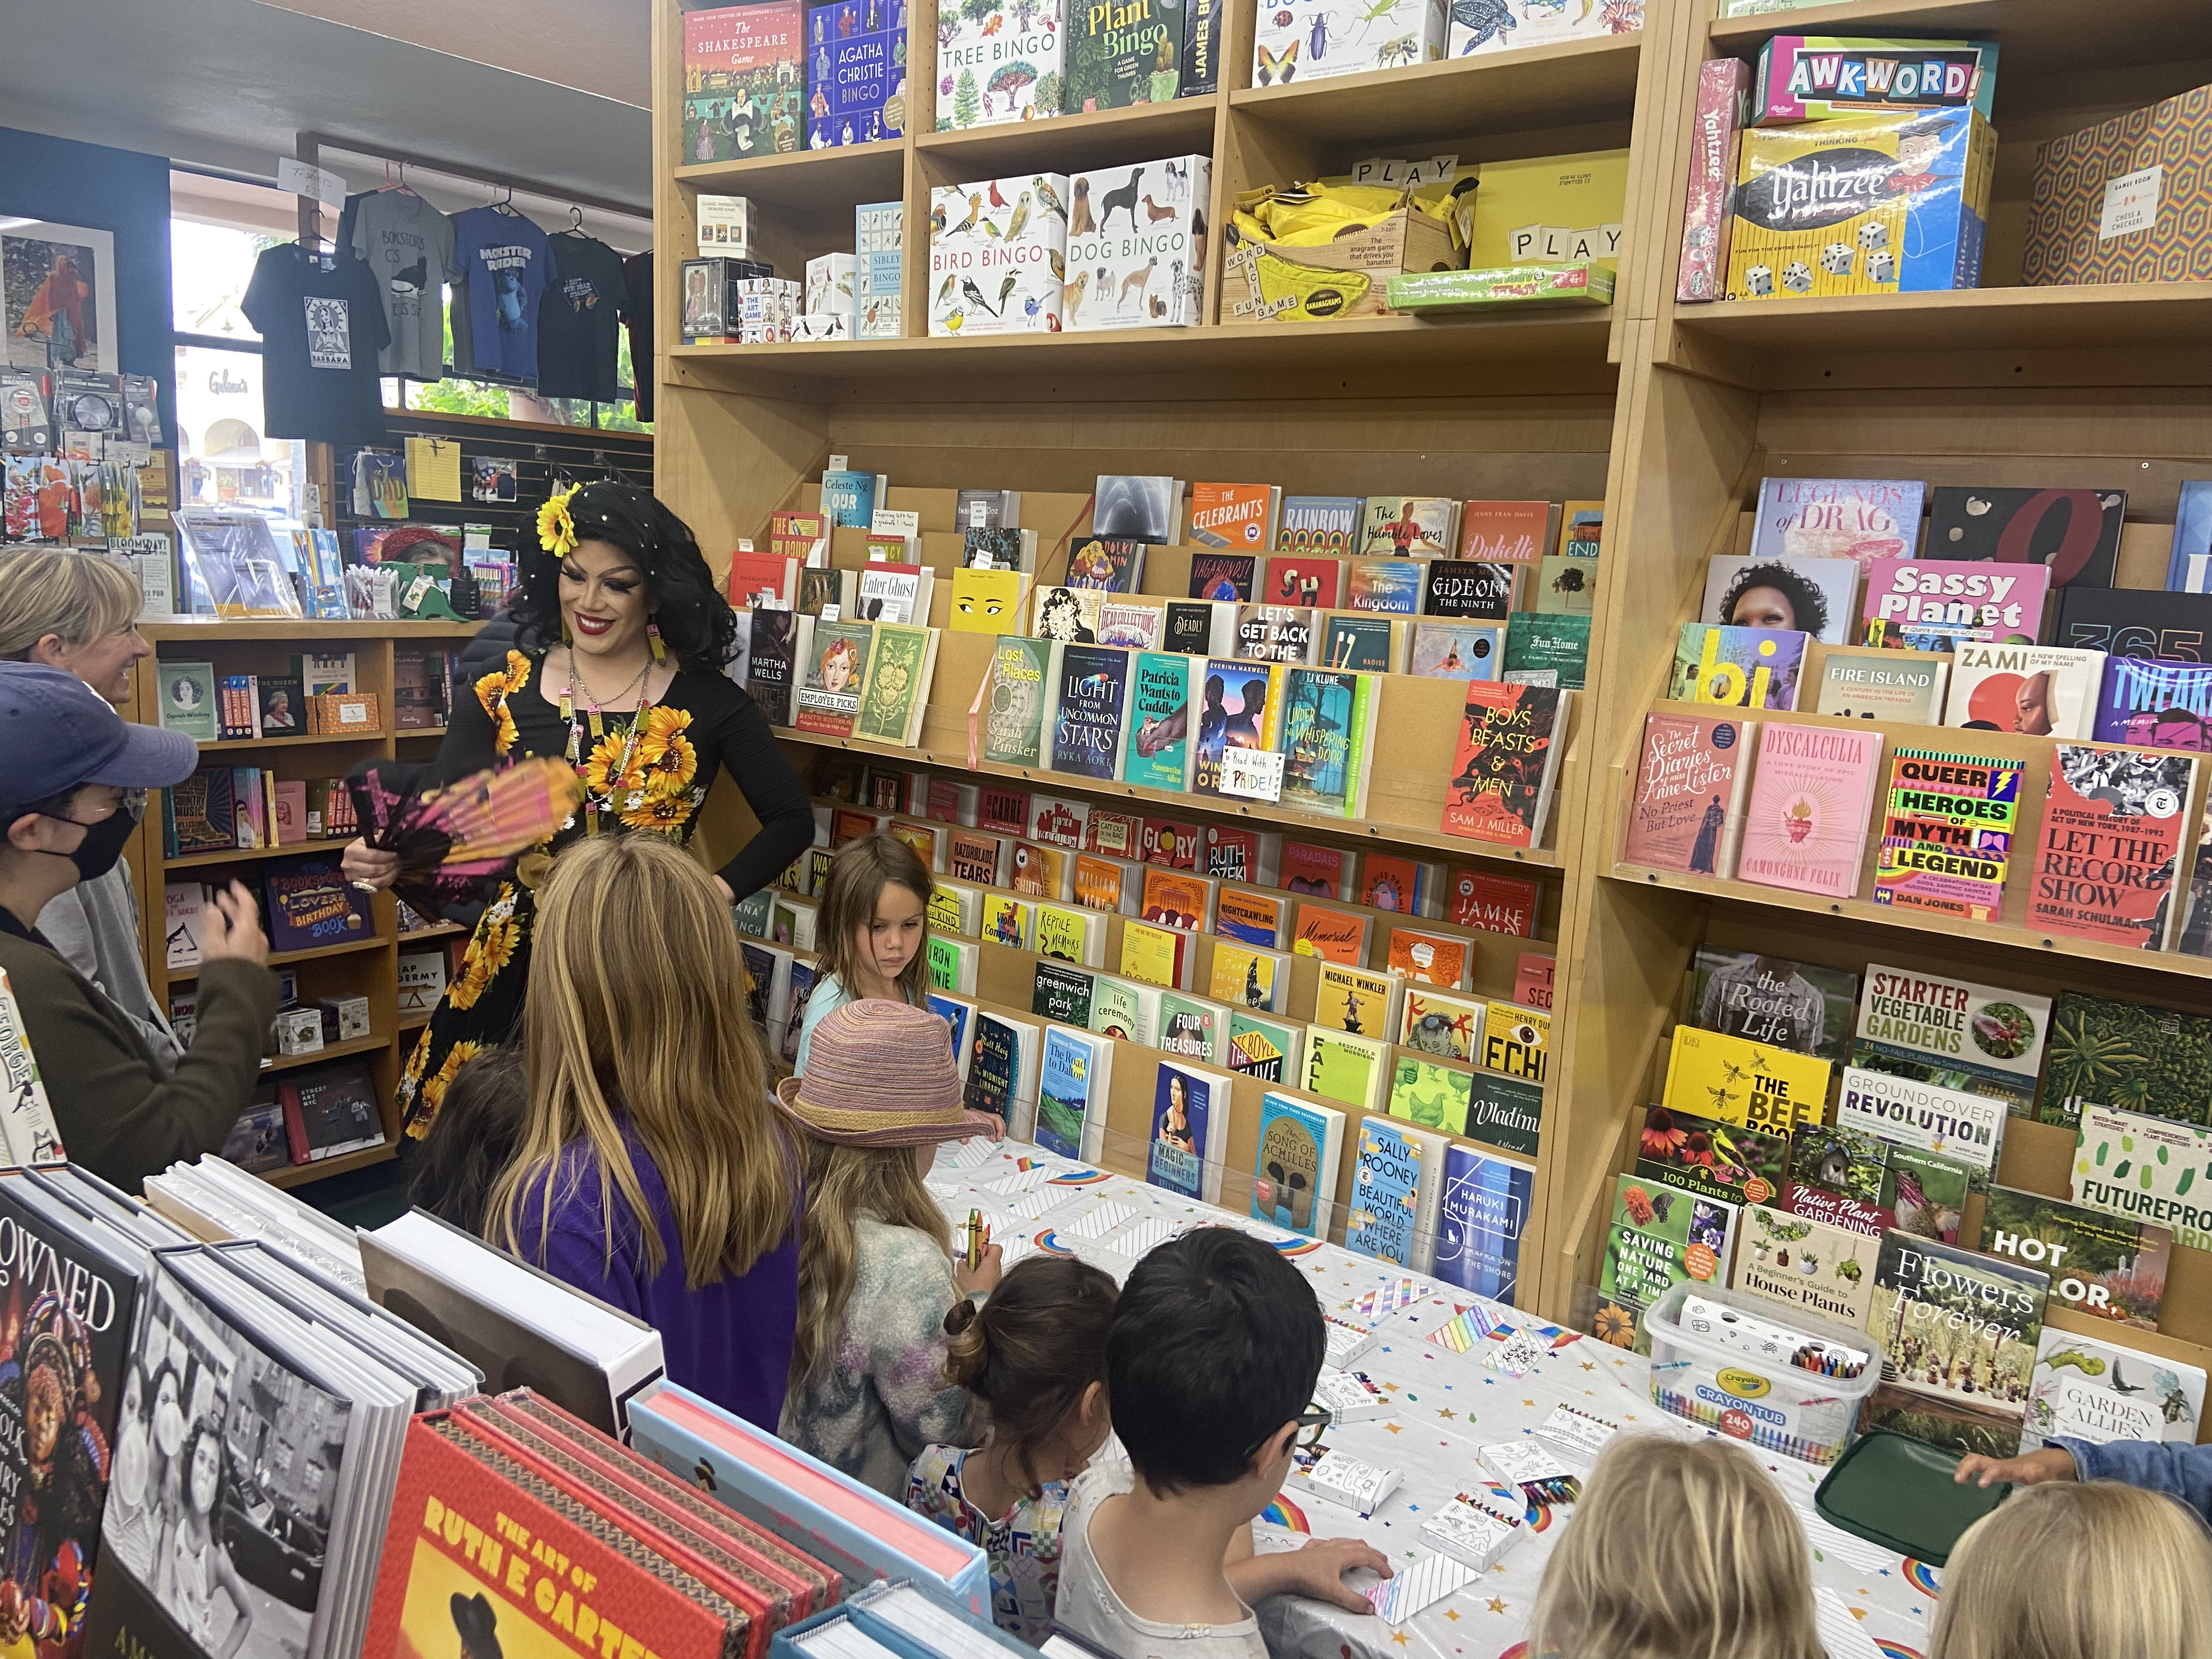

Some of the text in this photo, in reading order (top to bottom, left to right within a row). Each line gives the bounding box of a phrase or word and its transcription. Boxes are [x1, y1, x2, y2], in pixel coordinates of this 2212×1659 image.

[736, 21, 751, 34] The
[698, 33, 788, 53] SHAKESPEARE
[943, 33, 1056, 68] TREE BINGO
[1103, 24, 1167, 59] Bingo
[731, 53, 754, 65] Game
[838, 43, 883, 64] AGATHA
[838, 61, 884, 84] CHRISTIE
[1787, 55, 1982, 100] AWK-WORD!
[842, 84, 879, 104] BINGO
[1814, 136, 1858, 147] THINKING
[1770, 160, 1886, 220] Yahtzee
[2112, 217, 2143, 231] CHECKERS
[2115, 212, 2135, 222] CHESS
[934, 246, 1042, 271] BIRD BINGO
[1070, 232, 1184, 263] DOG BINGO
[1773, 244, 1795, 252] ENTIRE
[1306, 296, 1342, 311] BANANAGRAMS
[744, 312, 761, 320] GAME
[825, 479, 867, 492] Celeste Ng
[1221, 490, 1234, 502] THE
[1193, 499, 1263, 530] CELEBRANTS
[110, 539, 166, 550] BLOOMSDAY!
[863, 574, 915, 598] Enter Ghost
[1891, 566, 2017, 603] Sassy
[1257, 606, 1294, 622] LET'S
[1877, 594, 2022, 628] Planet
[1240, 624, 1309, 643] GET BACK
[752, 657, 787, 669] MARTHA
[998, 645, 1023, 662] Lost
[1962, 648, 2027, 671] ZAMI
[2055, 654, 2086, 663] SPELLING
[754, 668, 782, 680] WELLS
[1002, 663, 1040, 682] Places
[1210, 663, 1268, 675] EVERINA MAXWELL
[1307, 673, 1339, 686] TJ KLUNE
[1695, 629, 1776, 709] bi
[1831, 668, 1929, 687] FIRE ISLAND
[1068, 675, 1118, 703] LIGHT
[801, 693, 856, 709] EMPLOYEE PICKS
[1079, 699, 1101, 709] FROM
[1062, 707, 1118, 726] UNCOMMON
[1485, 707, 1532, 727] BOYS
[991, 721, 1022, 738] Sarah
[1059, 721, 1113, 752] STARS
[1471, 729, 1535, 753] BEASTS
[992, 737, 1036, 757] Pinsker
[1766, 730, 1862, 764] DYSCALCULIA
[1233, 770, 1272, 792] PRIDE!
[1474, 776, 1513, 798] MEN
[1901, 763, 1988, 788] QUEER
[1901, 792, 2007, 820] HEROES
[1450, 812, 1524, 836] SAM MILLER
[1951, 817, 1966, 826] OF
[2051, 815, 2066, 823] ACT
[2080, 819, 2098, 828] NEW
[2100, 821, 2119, 833] YORK,
[2121, 825, 2164, 837] 1987-1993
[1893, 820, 1971, 847] MYTH
[955, 842, 994, 865] RAZORBLADE
[1916, 842, 1943, 853] AND
[954, 860, 990, 884] TEARS
[1746, 857, 1840, 887] CAMONGHNE FELIX
[1897, 851, 1998, 879] LEGEND
[1897, 893, 1964, 912] DAN JONES
[2039, 877, 2125, 909] SHOW
[296, 903, 343, 927] BIRTHDAY
[1221, 904, 1273, 925] NIGHTCRAWLING
[2036, 903, 2076, 920] SARAH
[312, 918, 347, 937] BOOK
[1037, 975, 1090, 998] greenwich
[1324, 970, 1386, 996] MICHAEL WINKLER
[1757, 971, 1786, 994] the
[1874, 973, 1968, 1012] STARTER
[1048, 996, 1072, 1012] park
[1728, 983, 1810, 1022] Rooted
[1871, 995, 1966, 1031] VEGETABLE
[1176, 1014, 1201, 1031] FOUR
[1741, 1011, 1788, 1042] Life
[1866, 1014, 1962, 1054] GARDENS
[1160, 1035, 1212, 1057] TREASURES
[1338, 1041, 1369, 1053] GEOFFREY
[1343, 1047, 1375, 1060] MORRISON
[301, 1085, 326, 1096] STREET
[1848, 1075, 1995, 1123] GROUNDCOVER
[303, 1099, 317, 1107] NYC
[1846, 1090, 1992, 1147] REVOLUTION
[1267, 1131, 1315, 1156] SONG OF
[1378, 1137, 1410, 1163] SALLY
[1263, 1143, 1317, 1172] ACHILLES
[1893, 1150, 1963, 1175] Southern California
[1362, 1154, 1417, 1188] ROONEY
[1359, 1184, 1413, 1218] BEAUTIFUL
[1461, 1189, 1504, 1211] HARUKI
[1792, 1186, 1882, 1223] Native Plant
[1450, 1200, 1514, 1230] MURAKAMI
[1622, 1231, 1674, 1259] SAVING
[1994, 1229, 2068, 1267] HOT
[1619, 1248, 1672, 1276] NATURE
[1616, 1274, 1628, 1287] AT
[1617, 1262, 1669, 1286] ONE YARD
[1894, 1248, 2034, 1314] Flowers
[1745, 1272, 1855, 1318] House Plants
[1888, 1285, 2020, 1345] Forever
[1697, 1386, 1785, 1424] CRAYON TUB
[2067, 1389, 2154, 1427] GARDEN
[1725, 1413, 1749, 1430] 240
[2070, 1408, 2142, 1441] ALLIES
[424, 1494, 503, 1578] RUTH
[496, 1511, 597, 1594] THE ART OF
